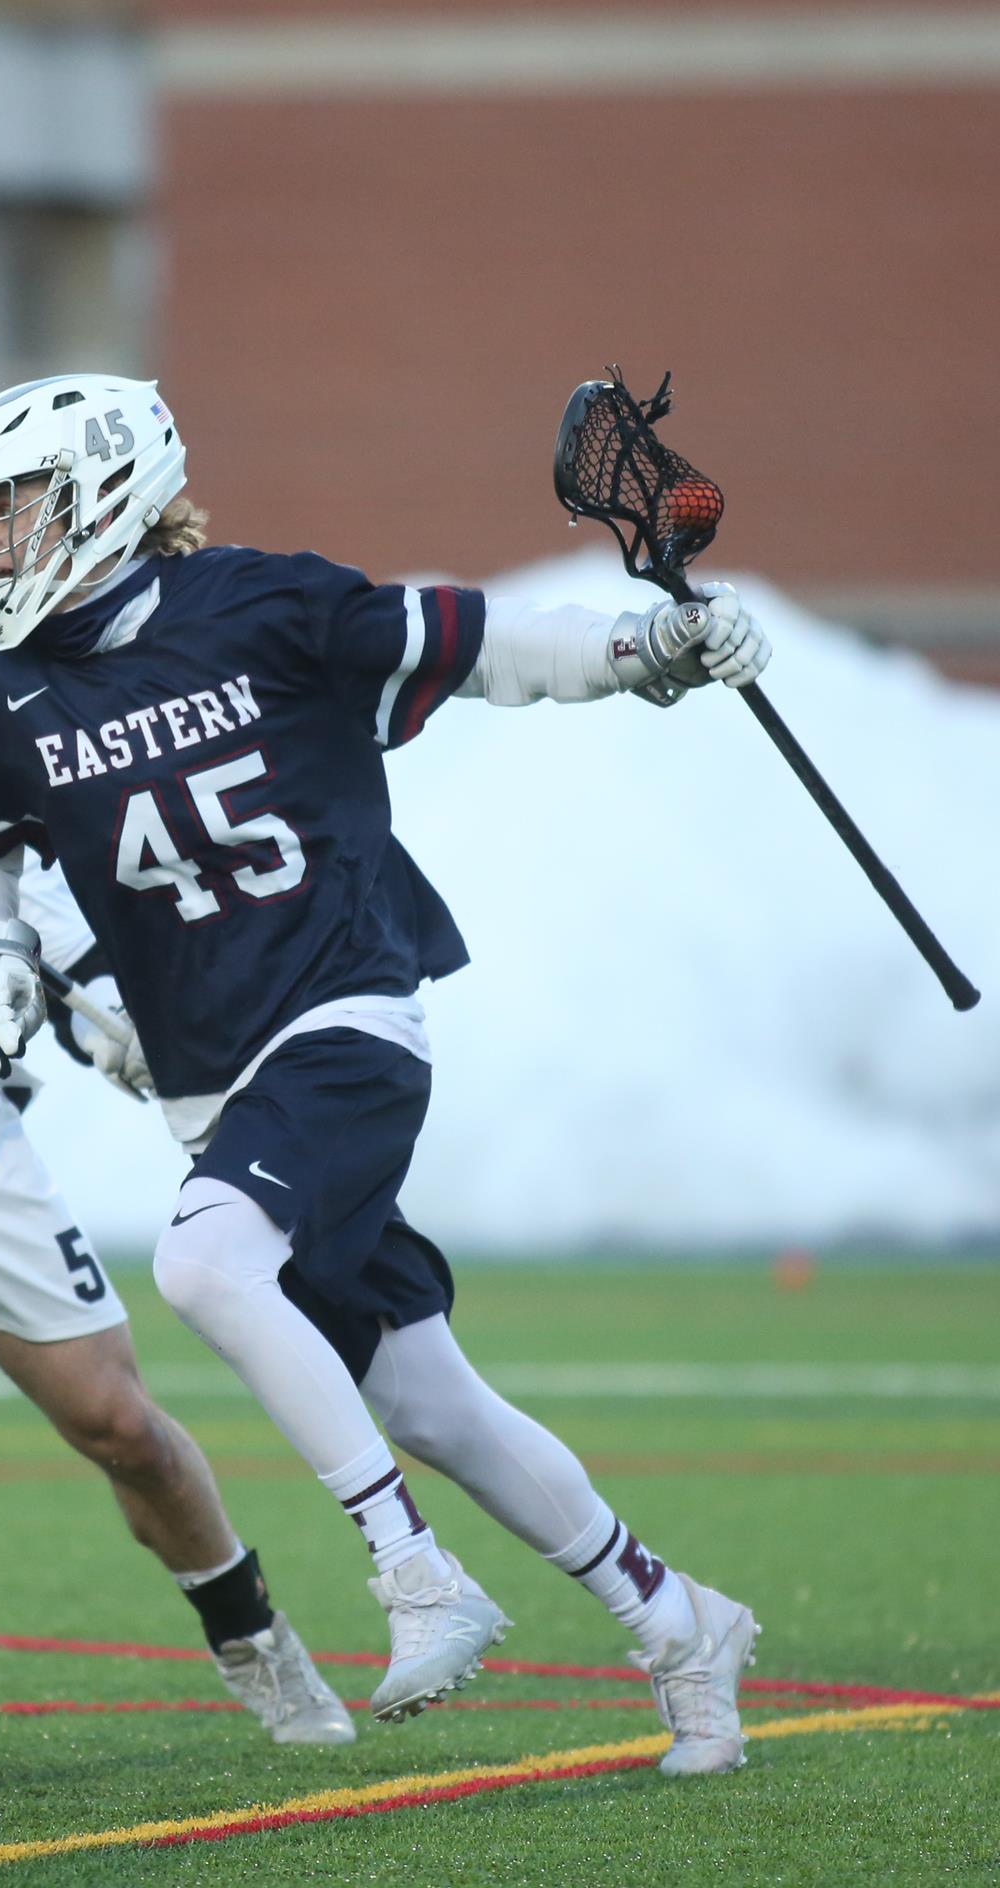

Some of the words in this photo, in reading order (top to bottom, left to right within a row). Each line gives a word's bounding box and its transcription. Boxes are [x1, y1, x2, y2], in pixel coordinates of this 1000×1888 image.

[85, 408, 135, 462] 45
[686, 608, 701, 625] 45
[35, 674, 261, 787] EASTERN
[113, 745, 310, 926] 45
[54, 1225, 106, 1304] 5
